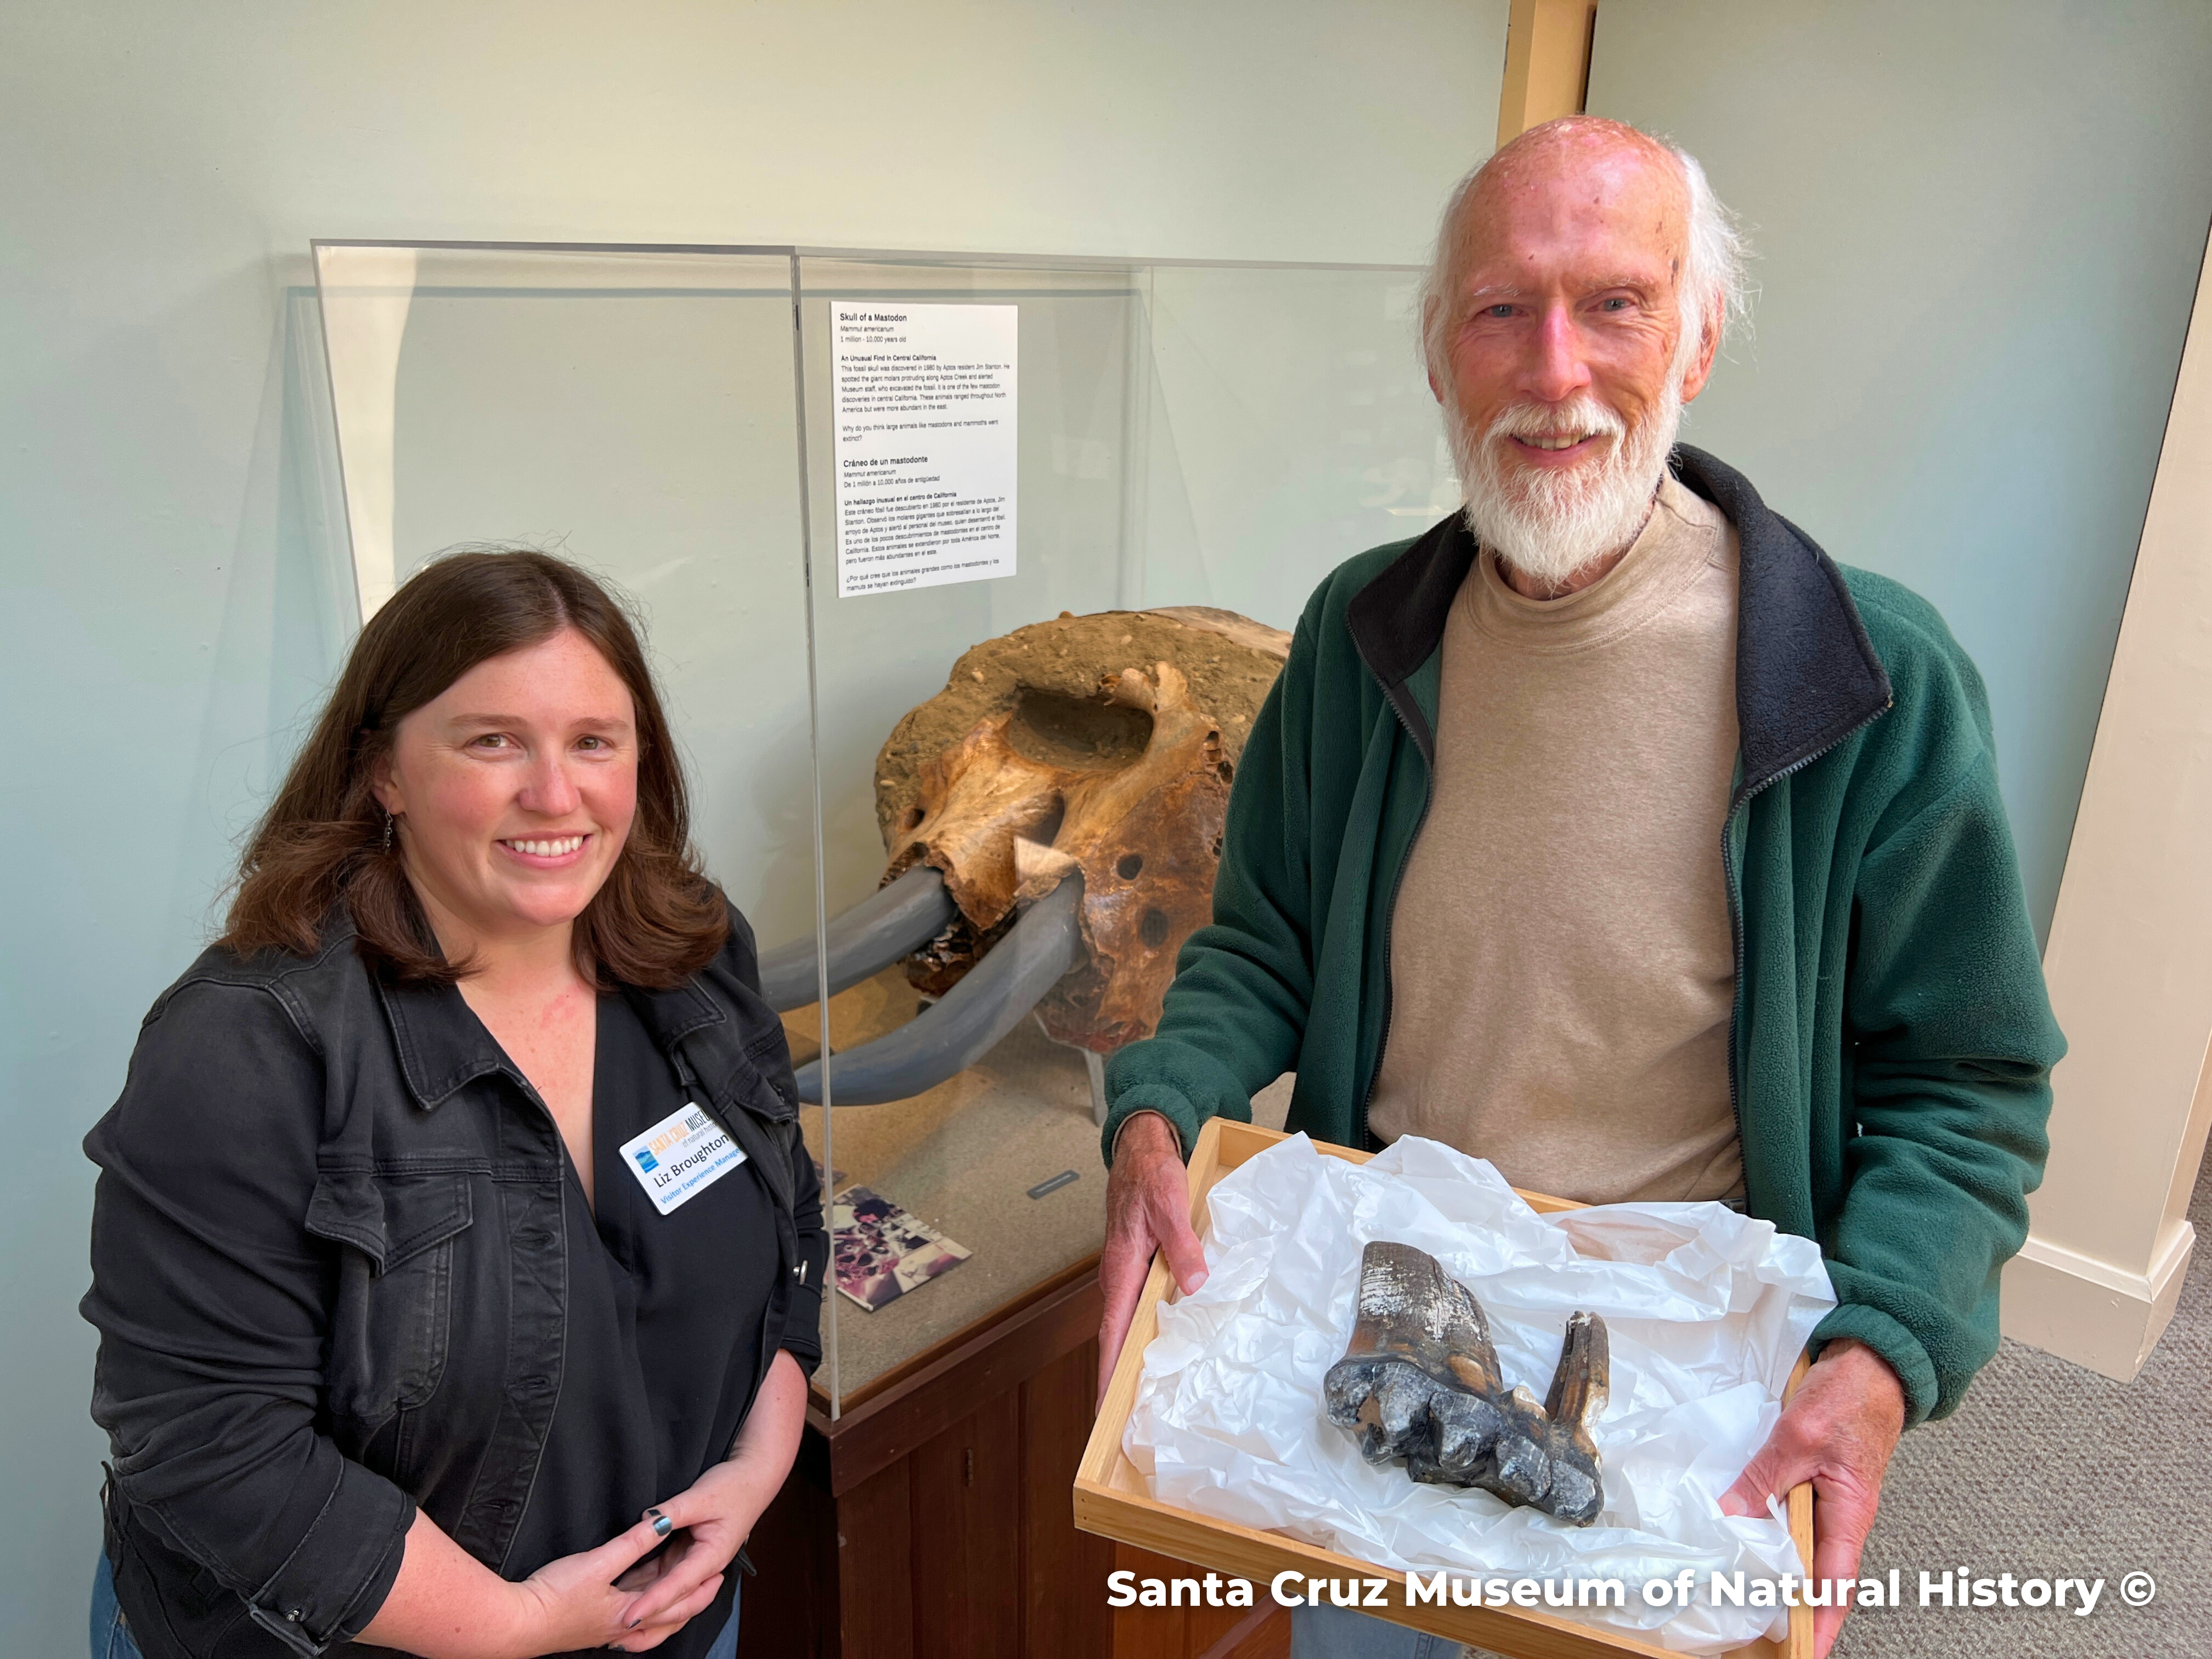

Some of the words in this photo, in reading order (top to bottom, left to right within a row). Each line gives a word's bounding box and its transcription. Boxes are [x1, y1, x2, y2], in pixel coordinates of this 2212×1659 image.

[890, 456, 928, 465] mastodonte
[648, 1132, 674, 1155] SANTA
[669, 1122, 690, 1143] CRUZ
[685, 1109, 712, 1132] MUSEU
[682, 1139, 689, 1148] of
[688, 1129, 705, 1143] natural
[704, 1122, 718, 1133] histo
[653, 1173, 672, 1188] Liz
[670, 1134, 730, 1177] Broughton
[661, 1187, 682, 1204] Visitor
[682, 1165, 716, 1190] Experience
